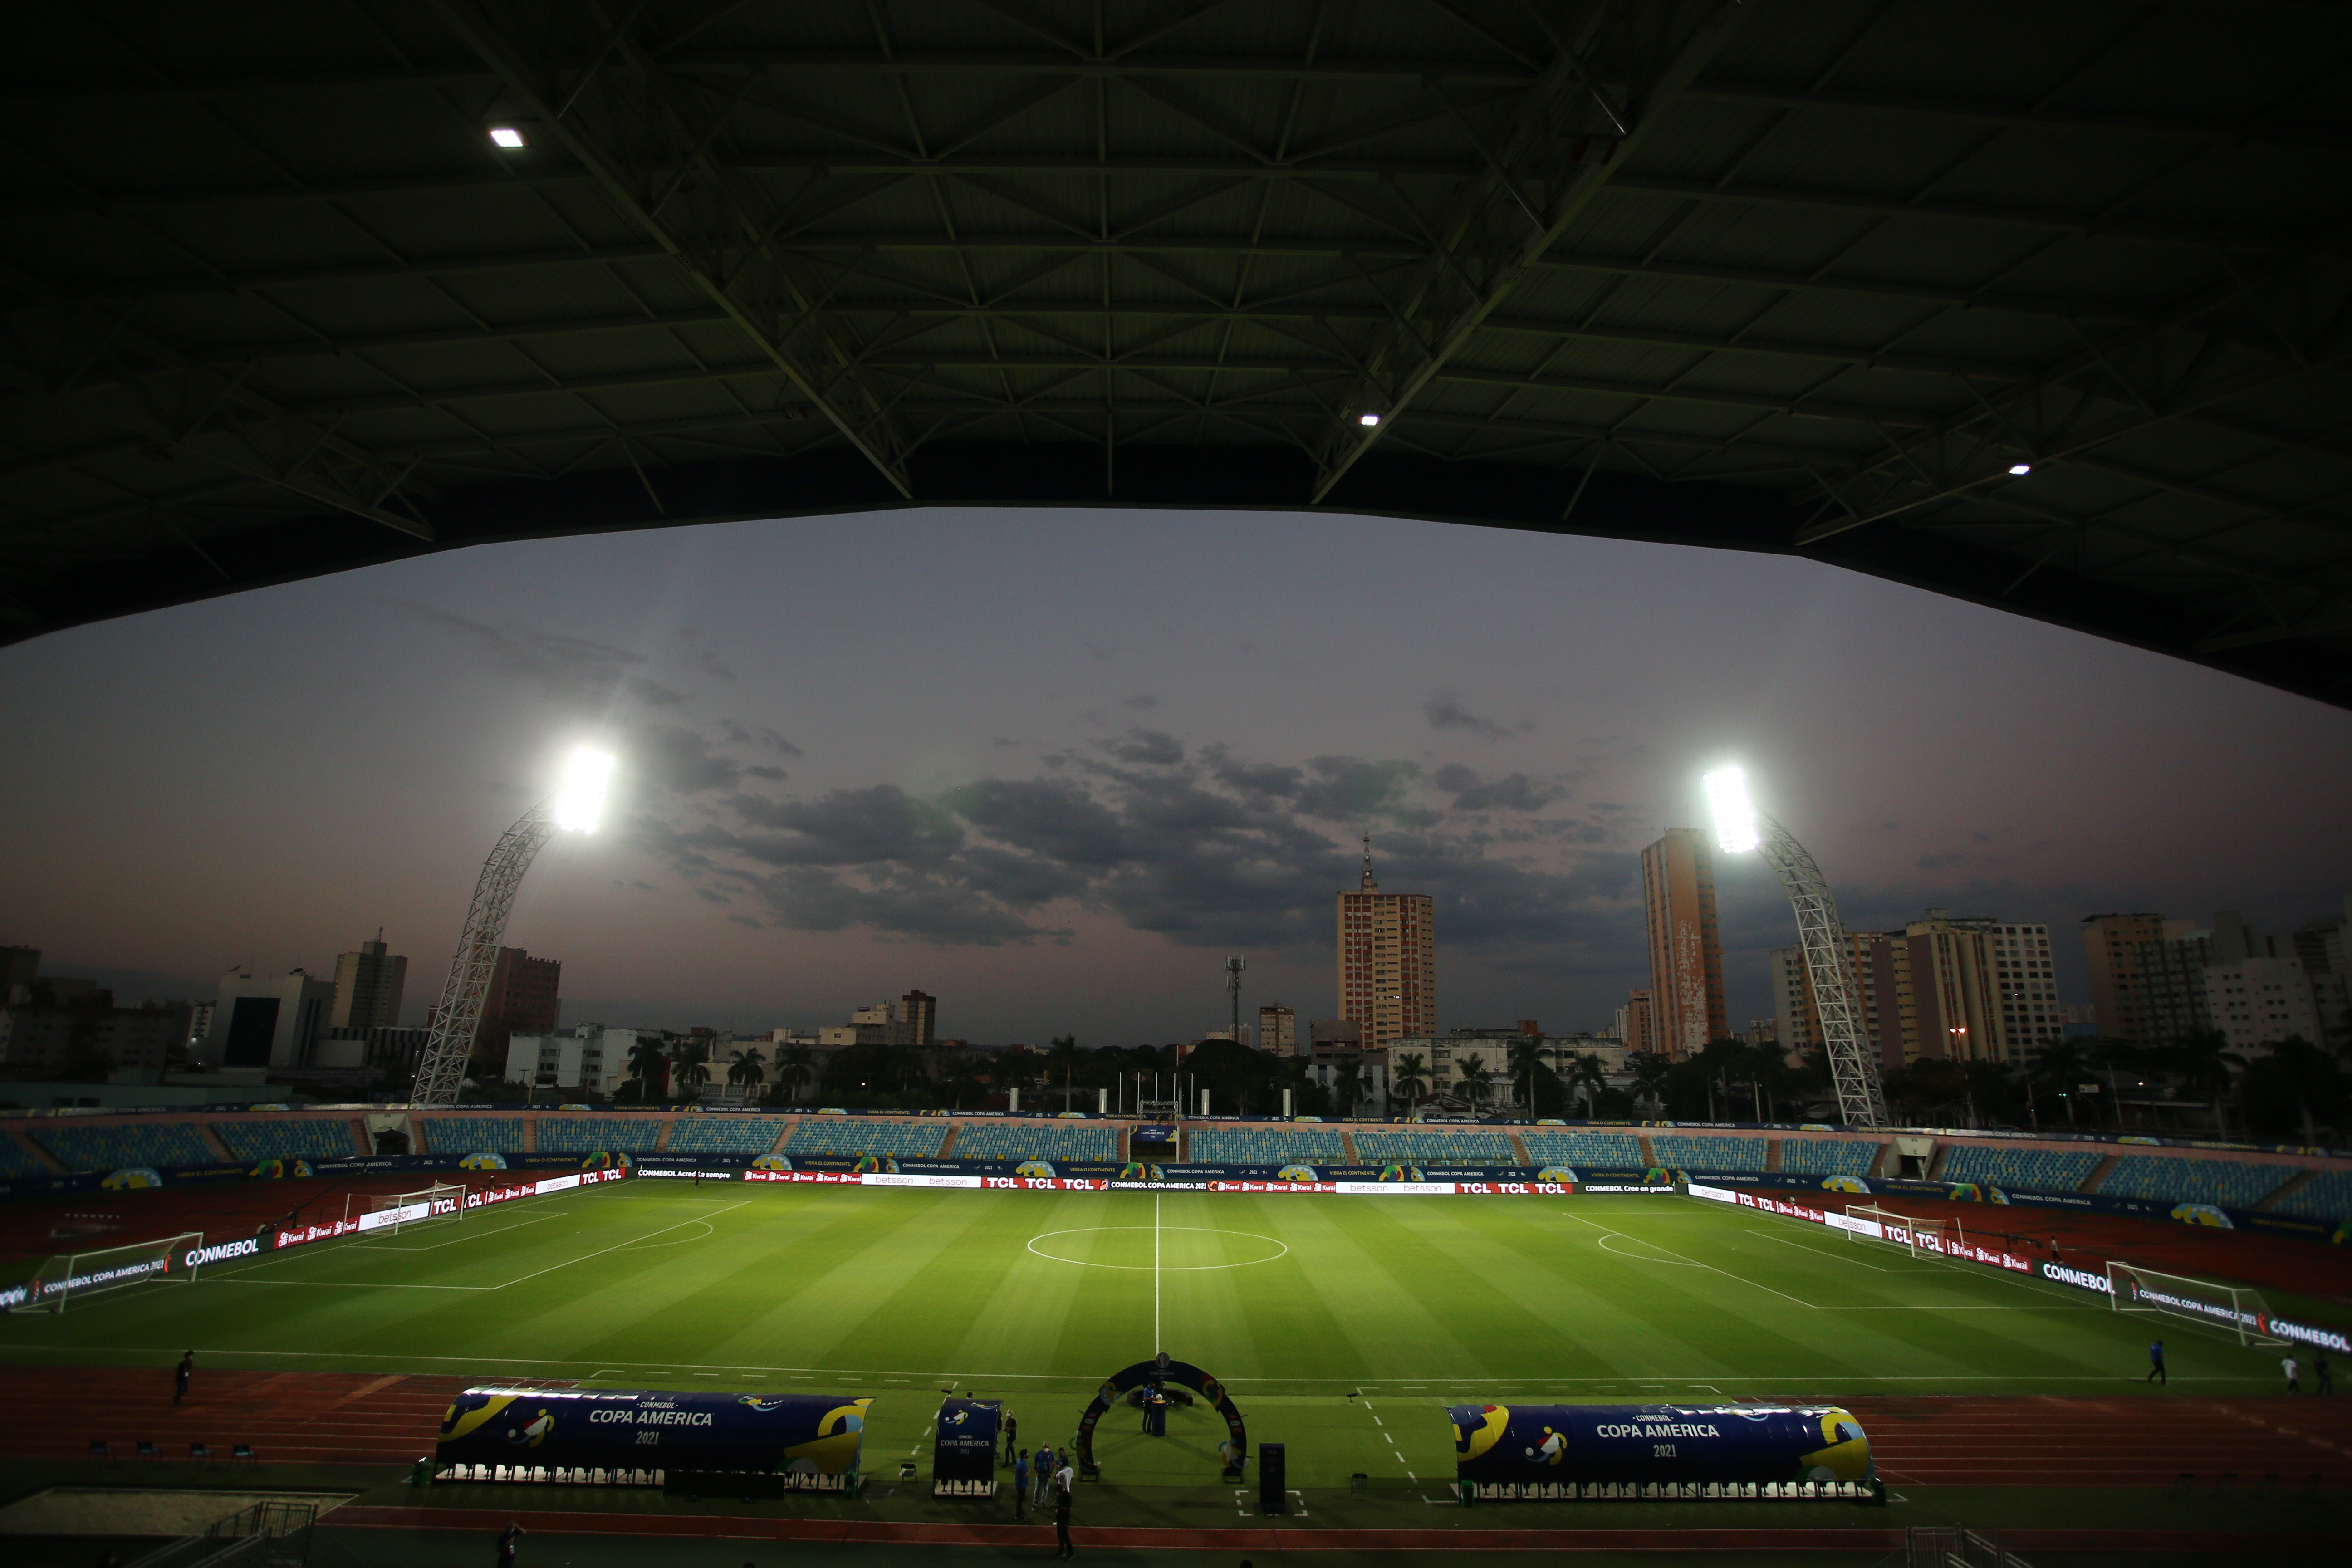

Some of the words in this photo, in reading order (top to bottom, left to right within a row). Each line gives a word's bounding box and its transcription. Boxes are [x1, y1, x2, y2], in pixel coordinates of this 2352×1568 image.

[582, 1172, 599, 1185] TCL
[603, 1168, 622, 1181] TCL
[875, 1176, 913, 1184] betsson
[930, 1177, 967, 1185] betsson
[547, 1179, 568, 1190] betsson
[987, 1177, 1019, 1188] TCL
[1024, 1178, 1056, 1189] TCL
[1063, 1179, 1094, 1190] TCL
[1350, 1184, 1387, 1192] betsson
[510, 1188, 519, 1198] Kwai
[526, 1186, 535, 1195] Kwai
[1460, 1183, 1492, 1194] TCL
[1498, 1183, 1529, 1194] TCL
[1535, 1183, 1566, 1194] TCL
[1650, 1185, 1673, 1193] grande
[1702, 1187, 1724, 1198] betsson
[494, 1192, 503, 1200] Kwai
[2012, 1193, 2043, 1201] CONMEBOL
[434, 1198, 456, 1215] TCL
[1738, 1193, 1755, 1207] TCL
[1757, 1197, 1775, 1212] TCL
[1784, 1205, 1793, 1214] Kwai
[1799, 1209, 1808, 1218] Kwai
[1814, 1213, 1824, 1221] Kwai
[343, 1221, 357, 1231] Kwai
[1838, 1217, 1866, 1231] besson
[288, 1231, 305, 1243] Kwai
[316, 1226, 332, 1237] Kwai
[1885, 1226, 1911, 1245] TCL
[1916, 1232, 1944, 1253] TCL
[185, 1238, 259, 1267] CONMEBOL
[1959, 1246, 1973, 1257] Kwai
[1984, 1252, 2000, 1264] Kwai
[2011, 1258, 2029, 1270] Kwai
[93, 1270, 115, 1283] COPA
[115, 1263, 150, 1279] AMERICA
[150, 1259, 164, 1270] 2021
[2043, 1263, 2116, 1294] CONMEBOL
[2139, 1289, 2180, 1307] CONMEBOL
[2181, 1299, 2202, 1312] COPA
[2240, 1313, 2257, 1326] 2021
[2270, 1319, 2352, 1353] CONMEBOL
[590, 1410, 633, 1423] COPA
[636, 1411, 712, 1426] AMERICA
[1597, 1424, 1643, 1438] COPA
[1646, 1424, 1721, 1437] AMERICA
[635, 1431, 659, 1445] 2021
[1653, 1444, 1677, 1458] 2021
